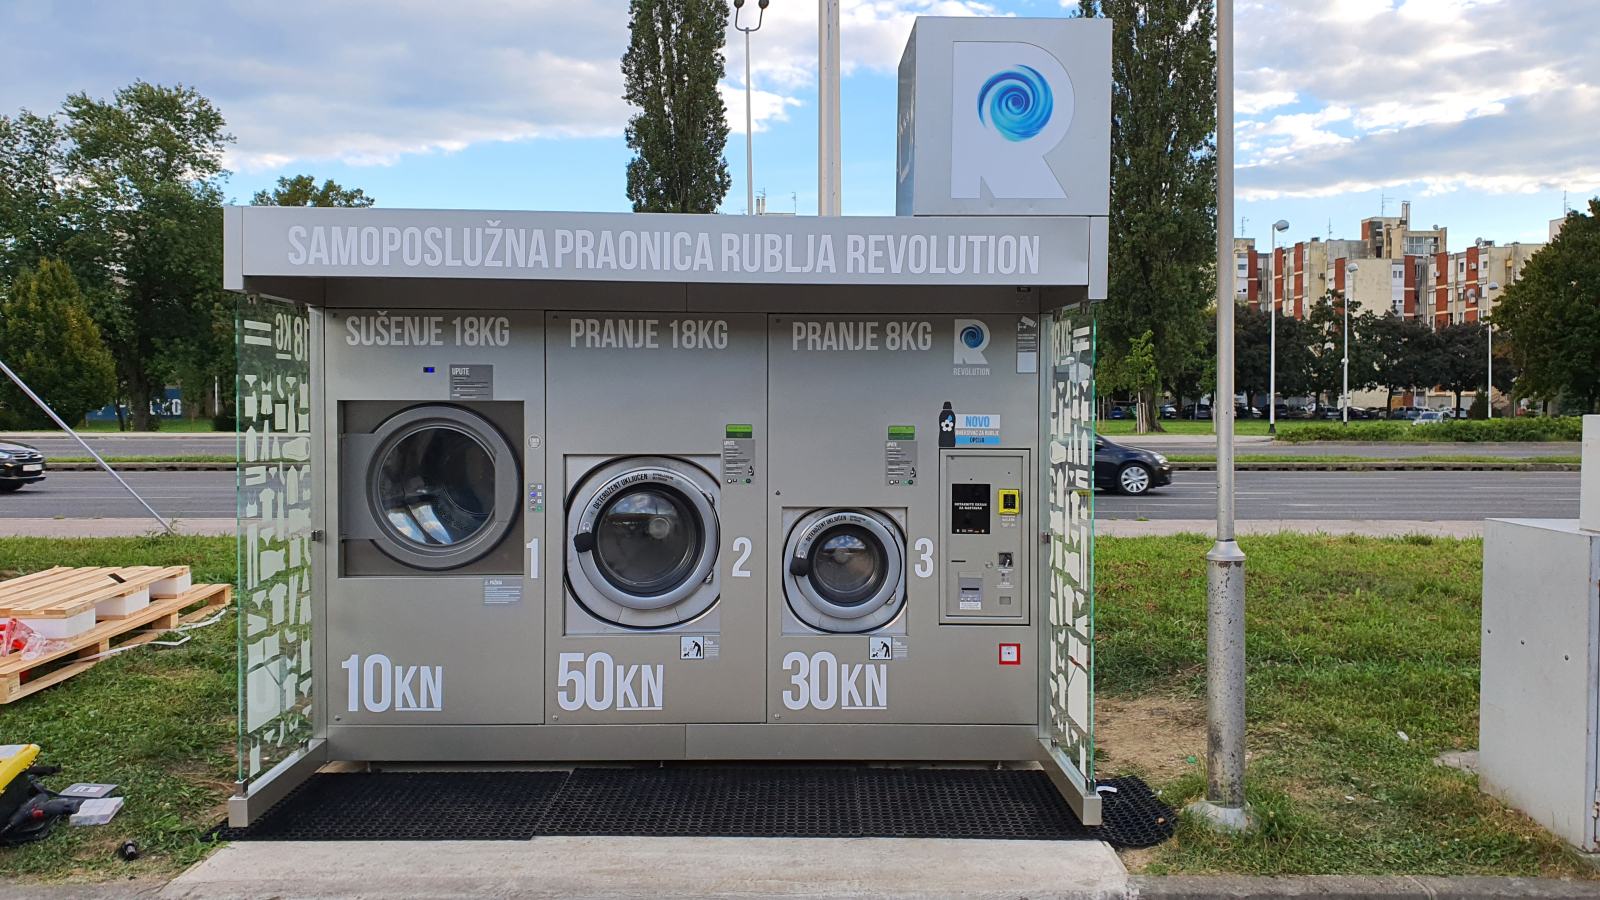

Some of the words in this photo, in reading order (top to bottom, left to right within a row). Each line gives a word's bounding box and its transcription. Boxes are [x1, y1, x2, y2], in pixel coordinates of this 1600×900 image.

[288, 219, 549, 269] SAMOPOSLUŽNA
[555, 229, 714, 272] PRAONICA
[721, 233, 837, 274] RUBLJA
[846, 234, 1040, 275] REVOLUTION
[345, 310, 444, 346] SUŠENJE
[452, 316, 510, 346] 18KG
[570, 318, 659, 349] PRANJE
[669, 319, 728, 349] 18KG
[792, 321, 879, 351] PRANJE
[885, 321, 932, 351] 8KG
[953, 367, 991, 376] REVOLUTION
[965, 415, 990, 428] NOVO
[526, 537, 539, 579] 1
[731, 536, 753, 578] 2
[914, 537, 934, 578] 3
